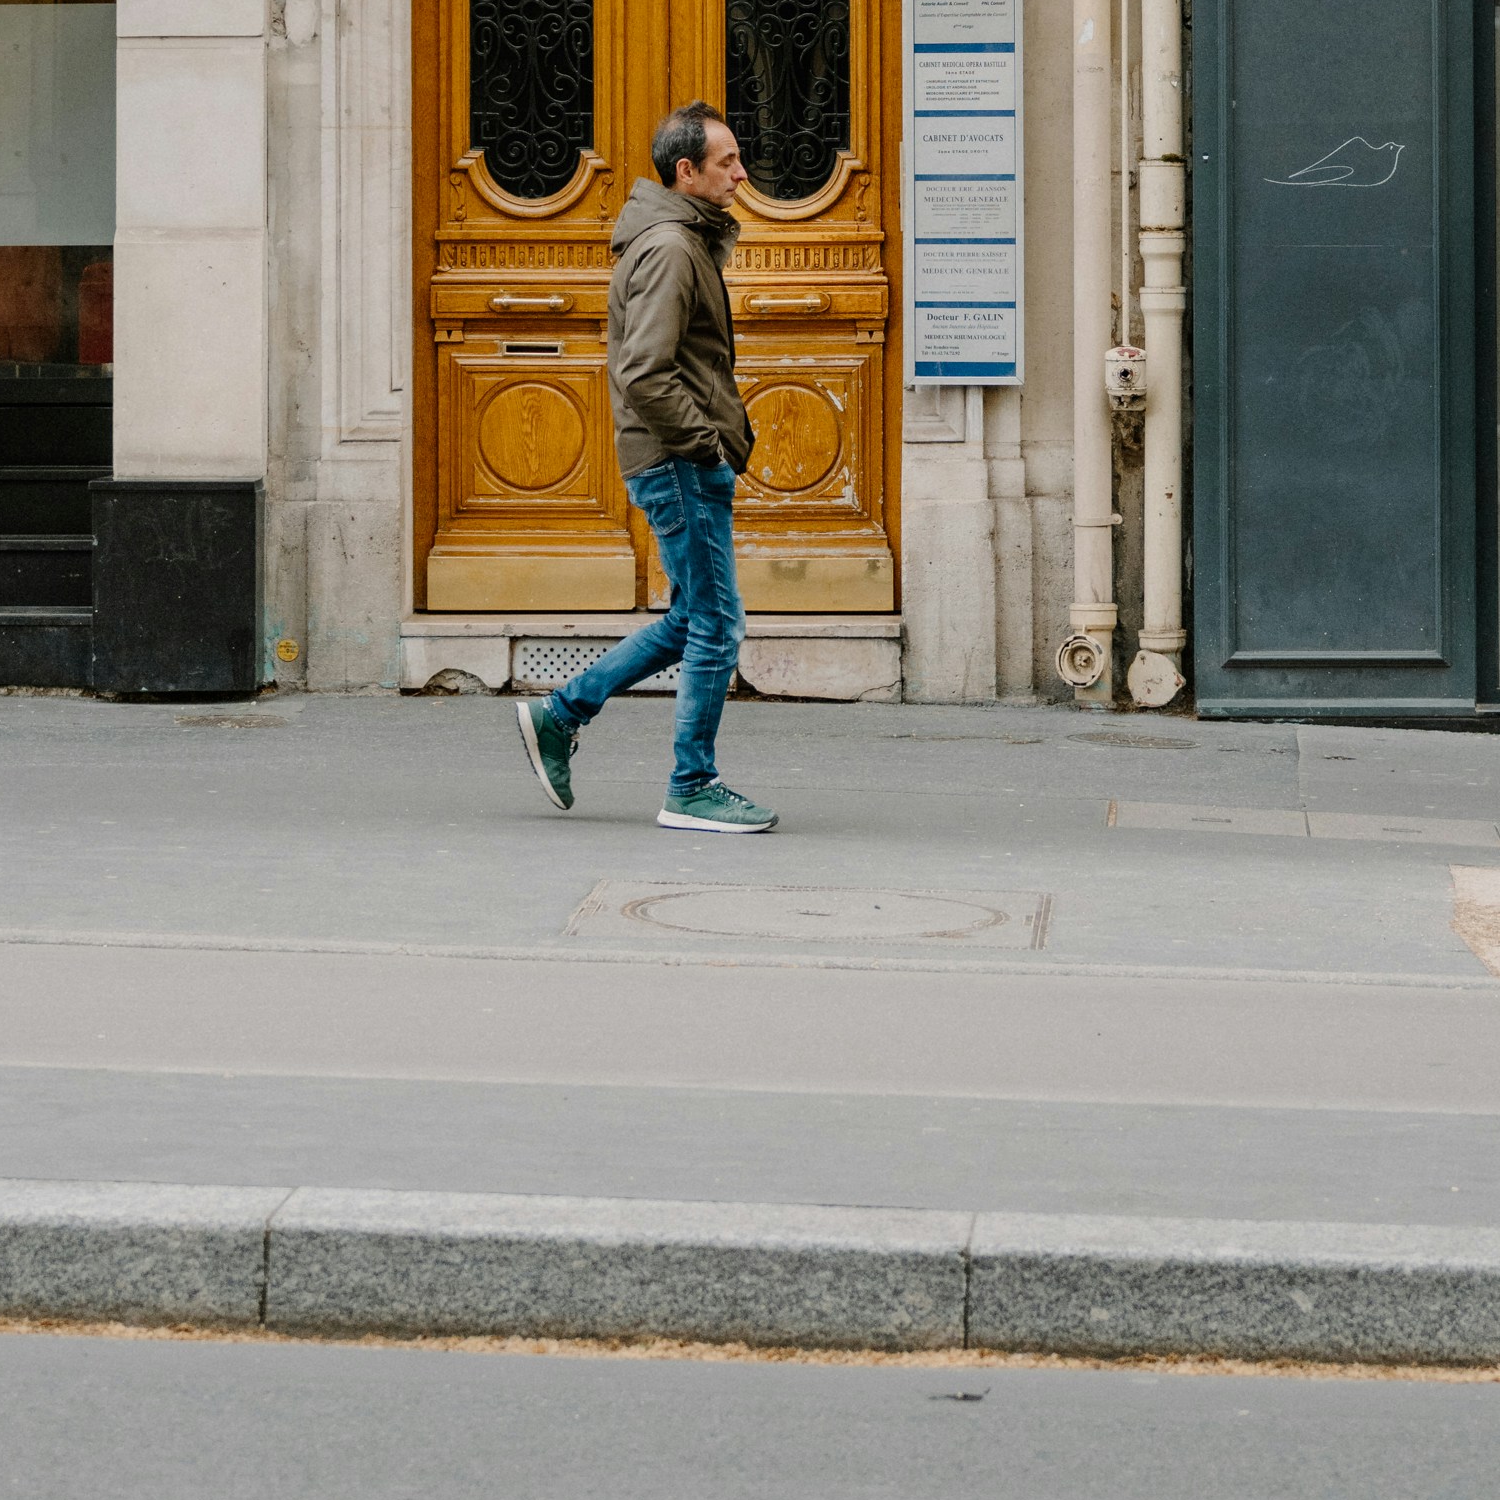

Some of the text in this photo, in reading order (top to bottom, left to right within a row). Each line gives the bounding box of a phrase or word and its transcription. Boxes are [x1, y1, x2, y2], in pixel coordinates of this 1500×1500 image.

[922, 134, 1004, 142] CABINET D'AVOCATS
[927, 313, 1004, 321] Docteur F. GALIN
